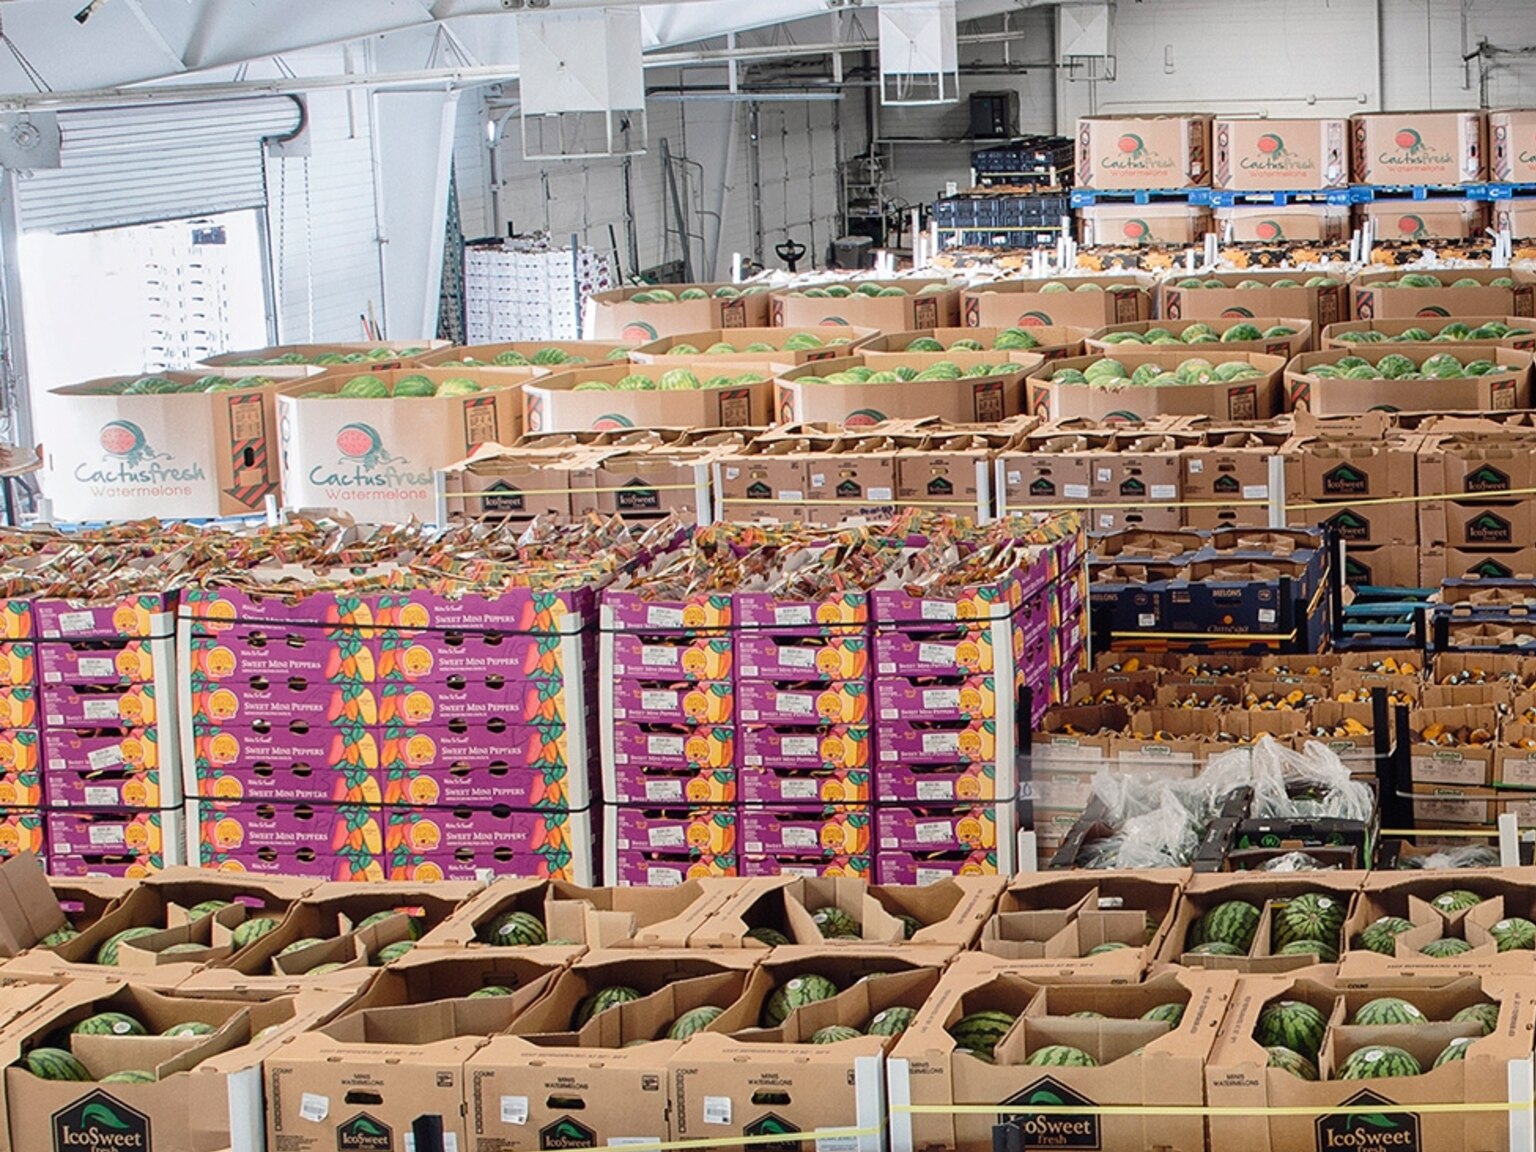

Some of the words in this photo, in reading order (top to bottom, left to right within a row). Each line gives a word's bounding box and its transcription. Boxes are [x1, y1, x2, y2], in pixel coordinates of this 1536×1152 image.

[90, 484, 192, 497] Watermelons
[325, 488, 427, 501] Watermelons
[1213, 589, 1241, 597] MELONS
[435, 614, 460, 623] SWEET
[242, 660, 266, 669] SWEET
[439, 658, 464, 666] SWEET
[244, 702, 269, 711] SWEET
[441, 702, 466, 711] SWEET
[248, 788, 274, 798] SWEET
[249, 832, 274, 841] SWEET
[1010, 1115, 1091, 1135] oSweet
[63, 1126, 142, 1148] IcoSweet
[342, 1132, 388, 1146] IcoSweet
[546, 1135, 593, 1149] IcoSweet
[1327, 1128, 1411, 1148] IcoSweet
